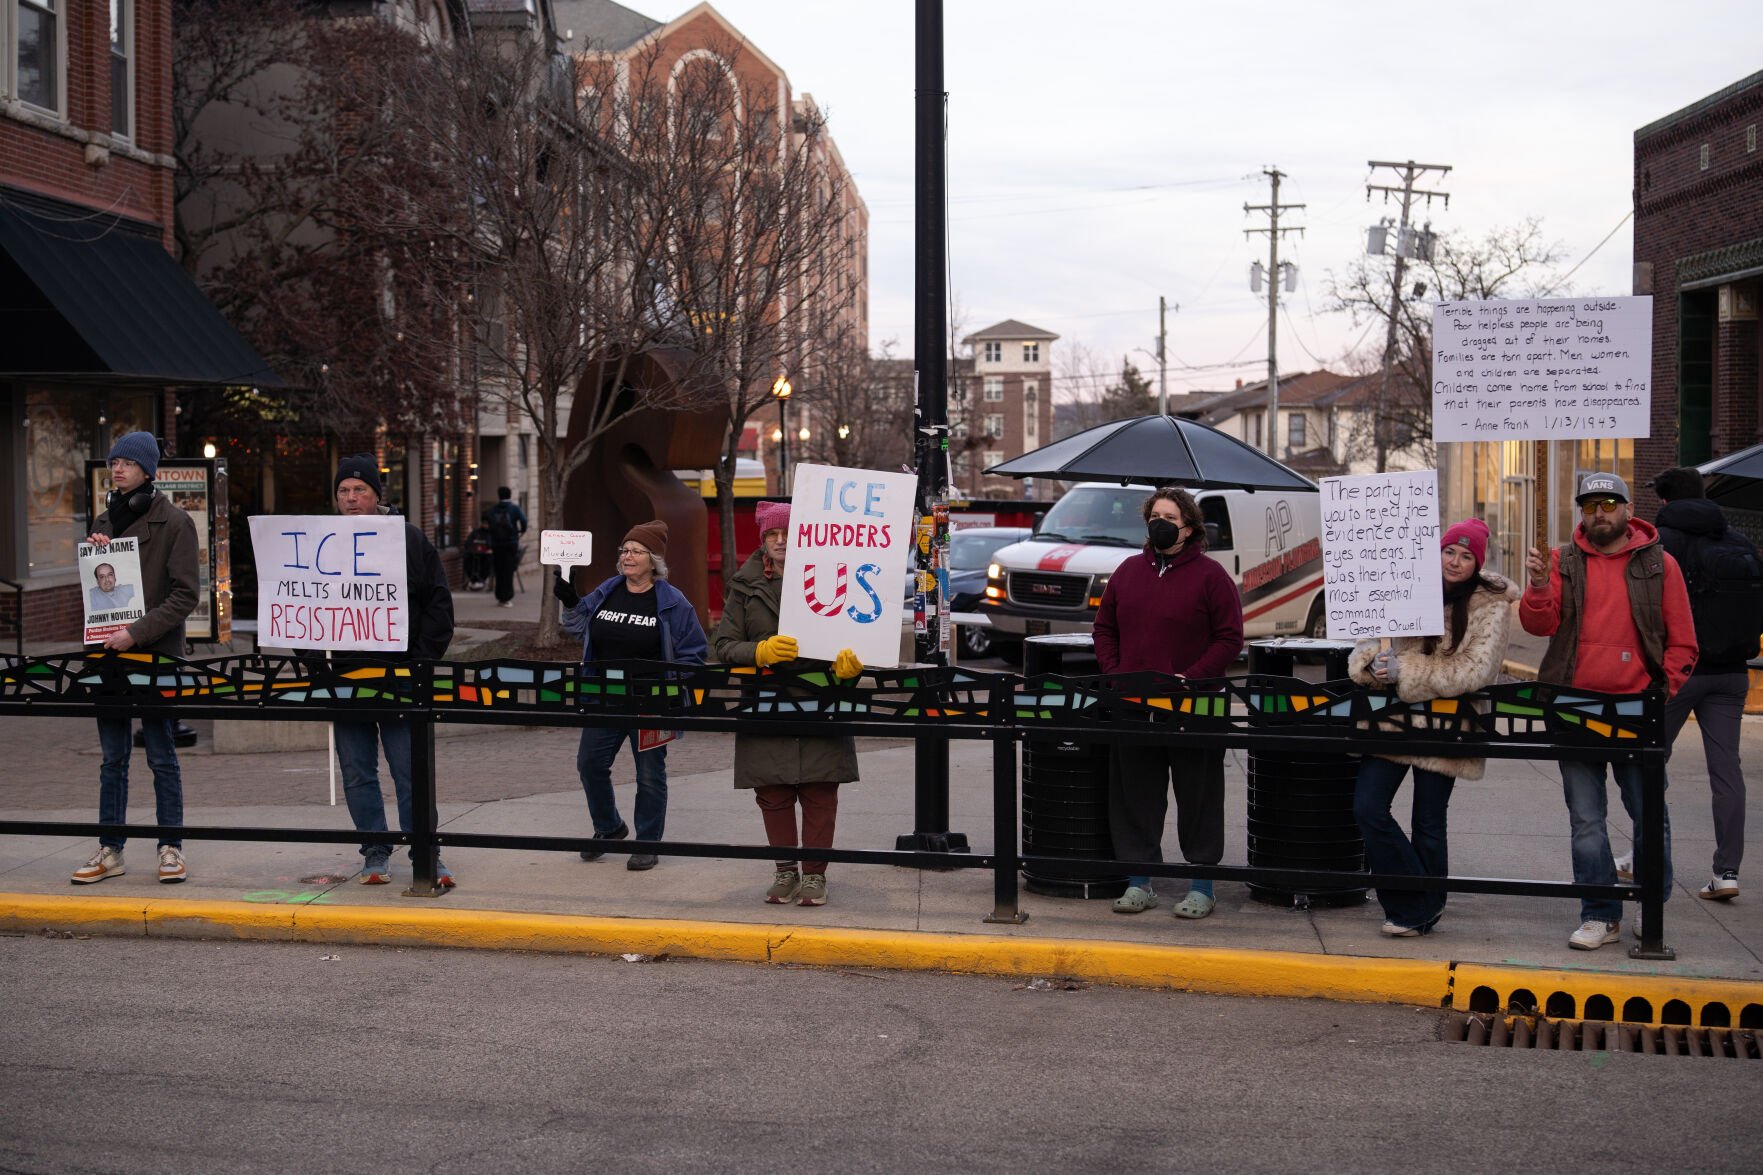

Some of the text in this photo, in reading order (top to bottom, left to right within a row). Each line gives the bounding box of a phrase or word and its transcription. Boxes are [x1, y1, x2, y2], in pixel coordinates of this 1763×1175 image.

[1437, 303, 1473, 316] Terrible
[1479, 304, 1508, 321] things
[1515, 306, 1530, 314] are
[1536, 303, 1576, 320] happening
[1453, 318, 1603, 335] Poor helpless people are being
[1461, 336, 1497, 351] dragged
[1504, 335, 1519, 345] out
[1525, 332, 1536, 345] of
[1543, 335, 1570, 345] their
[1437, 350, 1474, 363] Families
[1481, 353, 1496, 361] are
[1501, 350, 1521, 362] torn
[1526, 349, 1556, 364] apart.
[1560, 349, 1583, 360] Men
[1456, 368, 1474, 378] and
[1481, 368, 1517, 377] children
[1546, 365, 1601, 376] separated.
[1434, 378, 1646, 394] Children come home from school to find
[1443, 396, 1642, 413] that their parents have disappeared.
[1474, 417, 1499, 431] Anne
[1503, 417, 1529, 430] Frank
[156, 470, 205, 481] NTOWN
[1586, 479, 1615, 490] VANS
[823, 477, 886, 519] ICE
[1324, 479, 1434, 506] The party told
[1324, 500, 1429, 529] you to reject the
[797, 523, 892, 549] MURDERS
[1265, 500, 1293, 557] AP
[1325, 524, 1395, 545] evidence
[1397, 516, 1410, 539] of
[95, 545, 107, 556] HIS
[109, 540, 135, 554] NAME
[281, 531, 381, 577] ICE
[1325, 548, 1354, 568] eyes
[1359, 543, 1377, 560] and
[1410, 538, 1424, 560] It
[1358, 564, 1388, 583] their
[276, 580, 397, 602] MELTS UNDER
[803, 562, 883, 624] US
[1032, 583, 1062, 594] GMC
[1368, 584, 1413, 602] essential
[87, 609, 143, 624] JOHNNY NOVIELLO
[596, 609, 657, 627] FIGHT FEAR
[1330, 604, 1386, 621] command
[270, 603, 401, 642] RESISTANCE
[1349, 621, 1382, 637] George
[1388, 616, 1422, 633] Orwell
